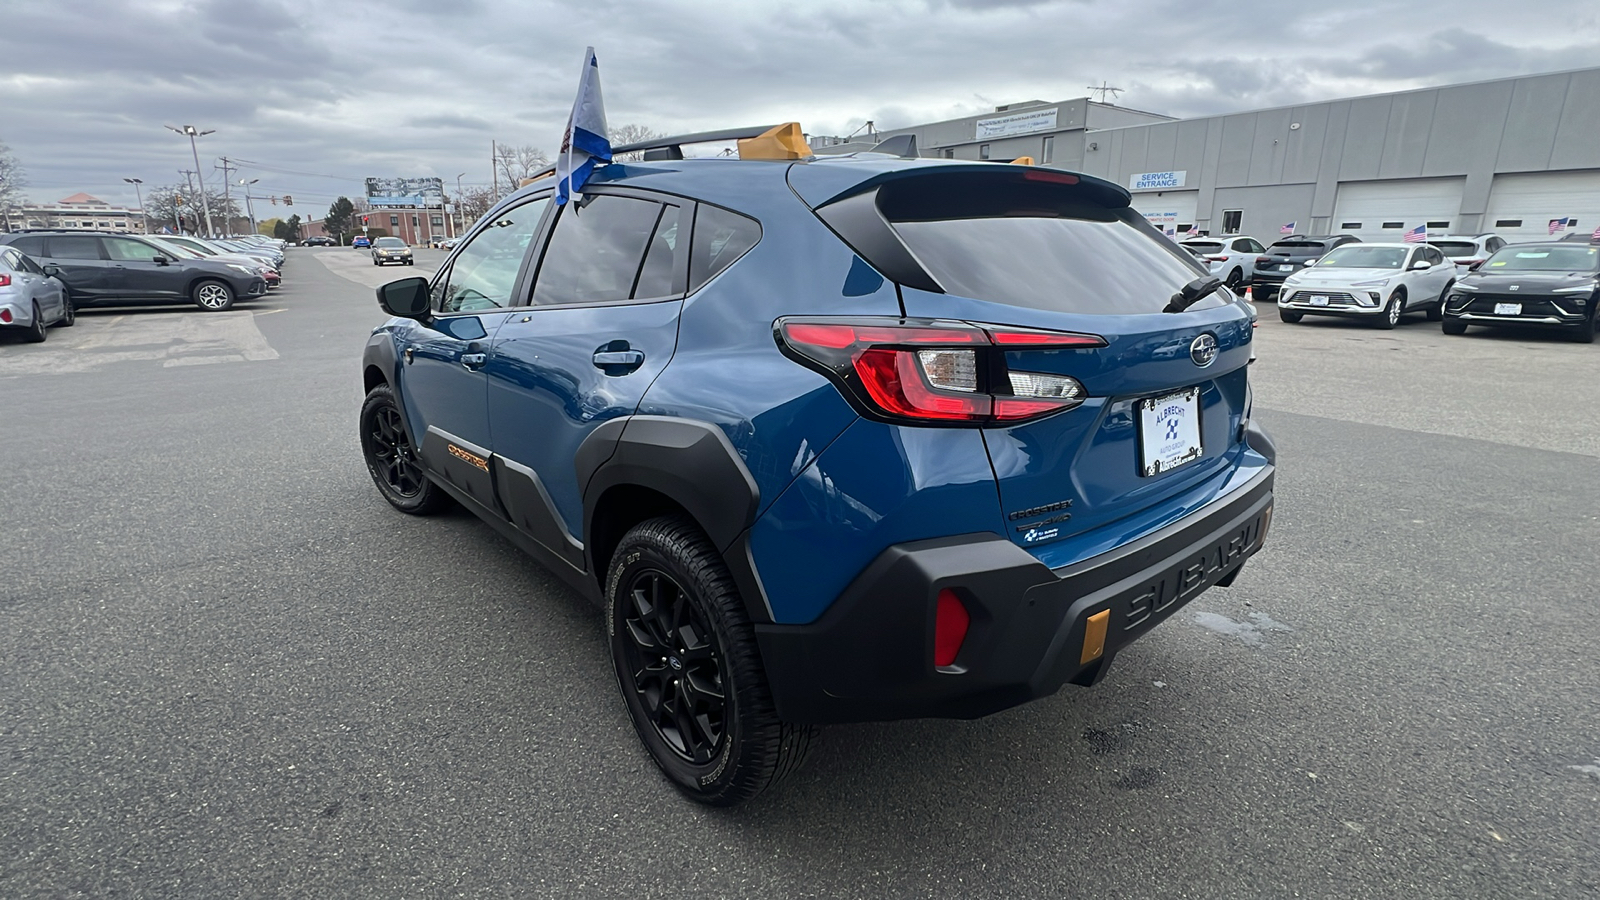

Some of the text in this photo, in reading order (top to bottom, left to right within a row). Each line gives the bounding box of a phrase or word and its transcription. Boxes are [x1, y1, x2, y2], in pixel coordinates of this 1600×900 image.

[1136, 179, 1177, 188] ENTRANCE
[1141, 172, 1174, 181] SERVICE
[1156, 405, 1185, 426] ALBRECHT
[1160, 440, 1186, 454] AUTO GROUP
[1009, 498, 1073, 521] CROSSTREK
[1124, 516, 1261, 631] SUBARU
